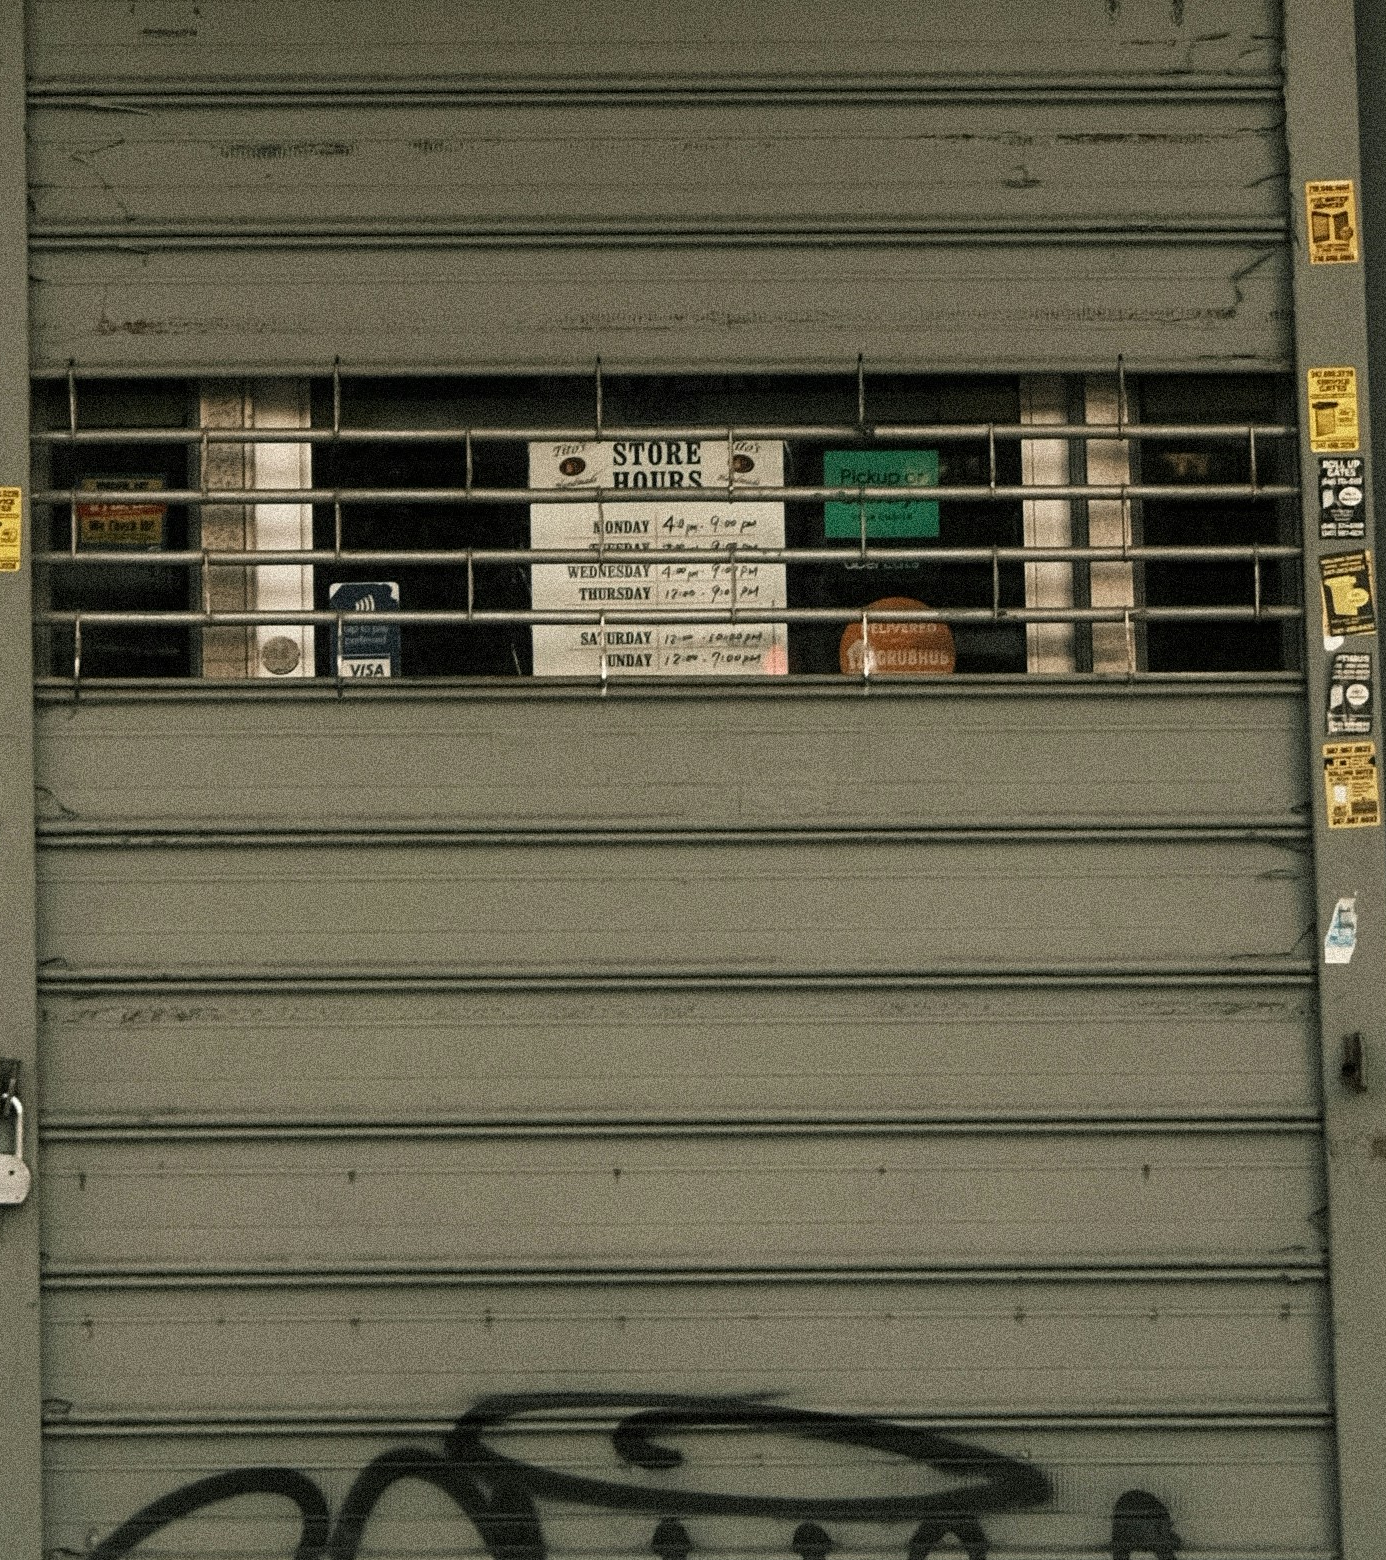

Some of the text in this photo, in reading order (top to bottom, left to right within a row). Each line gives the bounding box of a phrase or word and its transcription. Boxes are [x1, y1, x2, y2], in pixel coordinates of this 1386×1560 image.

[613, 441, 702, 467] STORE
[613, 470, 703, 488] HOURS
[840, 468, 925, 485] Pickup or
[567, 564, 651, 579] WEDNESDAY
[578, 586, 651, 601] THURSDAY
[862, 623, 937, 635] ELIVERED
[580, 630, 653, 646] SAURDAY
[600, 653, 653, 667] UNDAY
[877, 648, 950, 666] GRUBHUB
[349, 663, 386, 677] VISA
